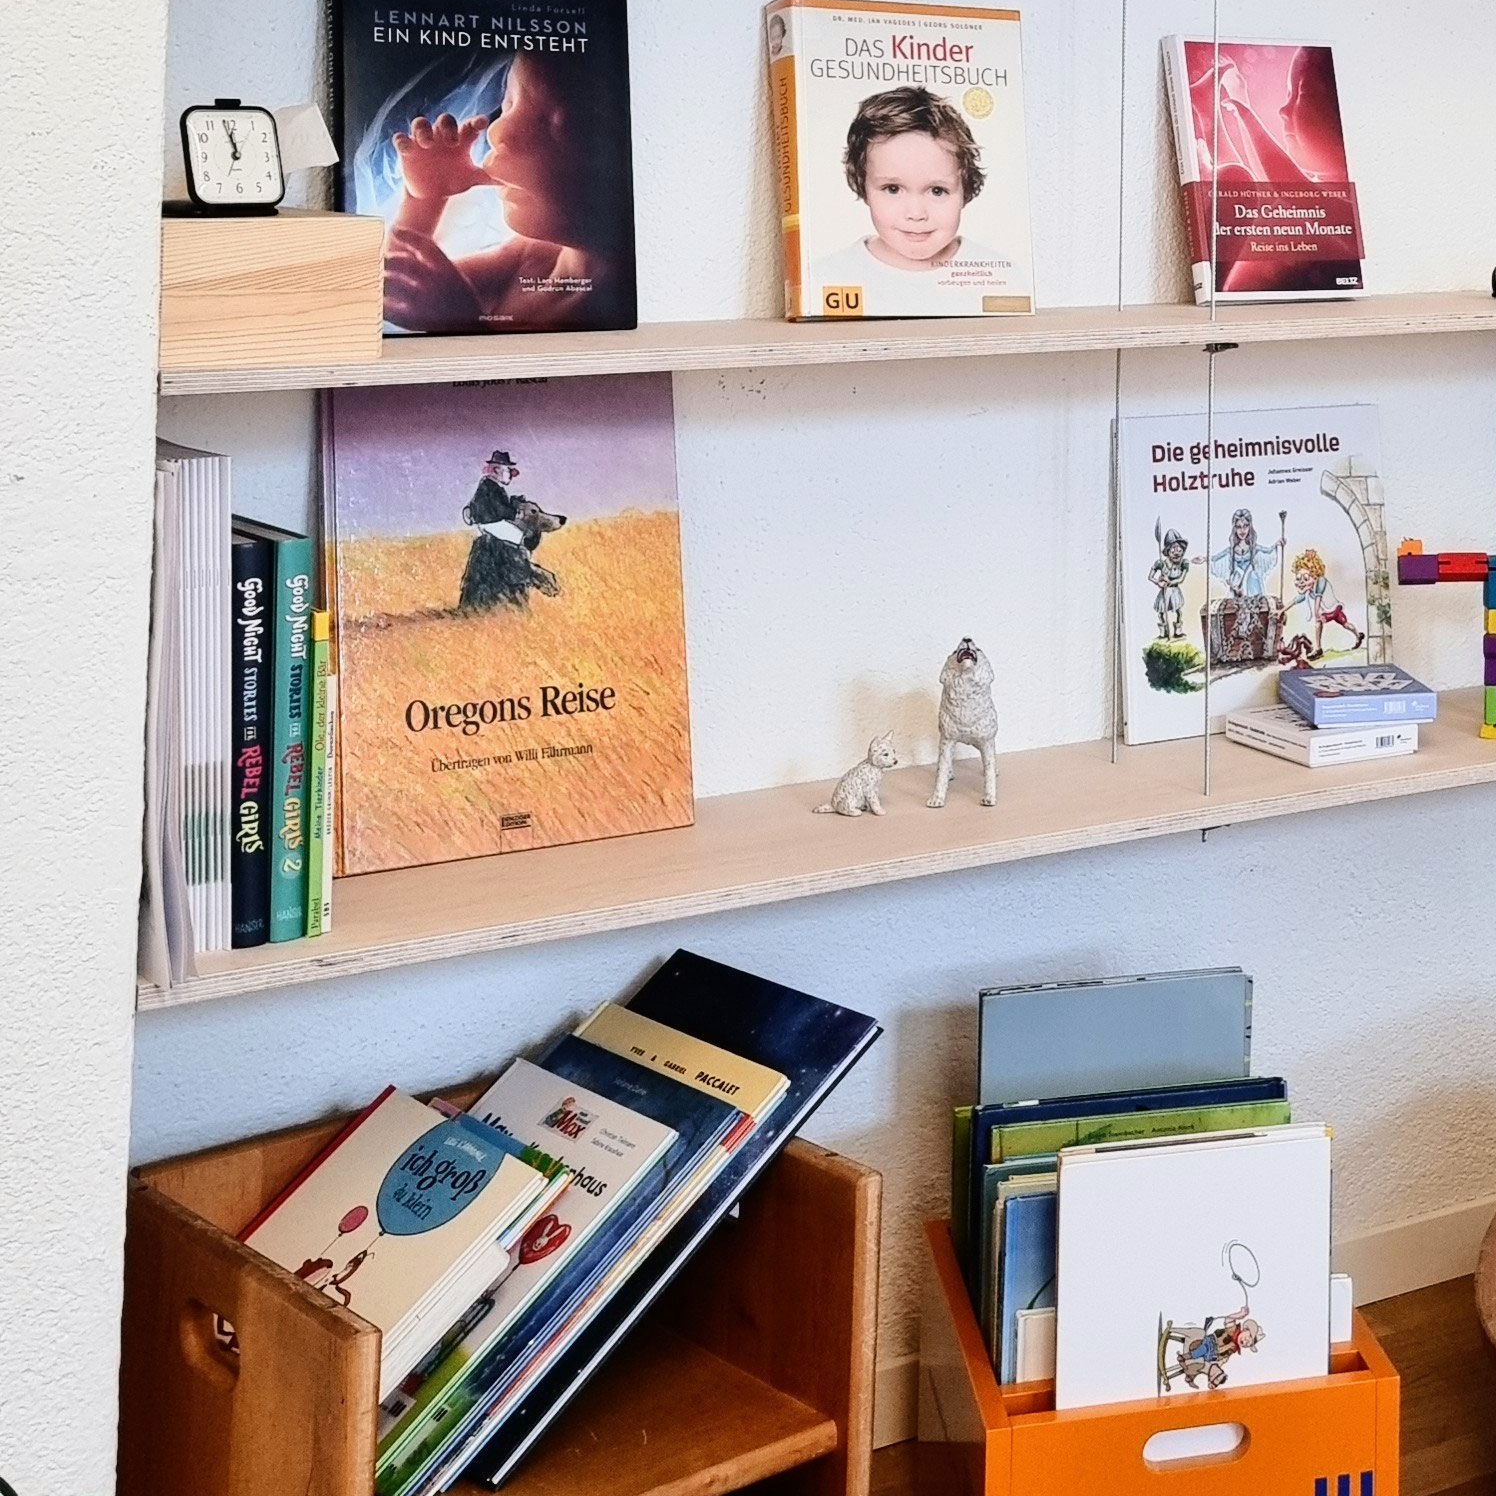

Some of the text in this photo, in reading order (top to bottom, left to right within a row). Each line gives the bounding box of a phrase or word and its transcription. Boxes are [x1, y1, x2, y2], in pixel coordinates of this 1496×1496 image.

[373, 9, 587, 35] LENNART NILSSON
[373, 26, 589, 54] EIN KIND ENTSTEHT
[844, 34, 974, 62] DAS Kinder
[251, 120, 254, 131] 1
[197, 132, 208, 143] 10
[779, 76, 793, 213] GESUNDHEITSBUCH
[201, 152, 208, 163] 9
[264, 152, 270, 162] 3
[266, 171, 272, 181] 4
[216, 183, 222, 194] 7
[236, 183, 243, 193] 6
[1251, 241, 1318, 253] Reise ins Leben
[1152, 433, 1341, 465] Die geheimnisvolle
[1152, 468, 1255, 493] Holztruhe
[404, 682, 616, 737] Oregons Reise
